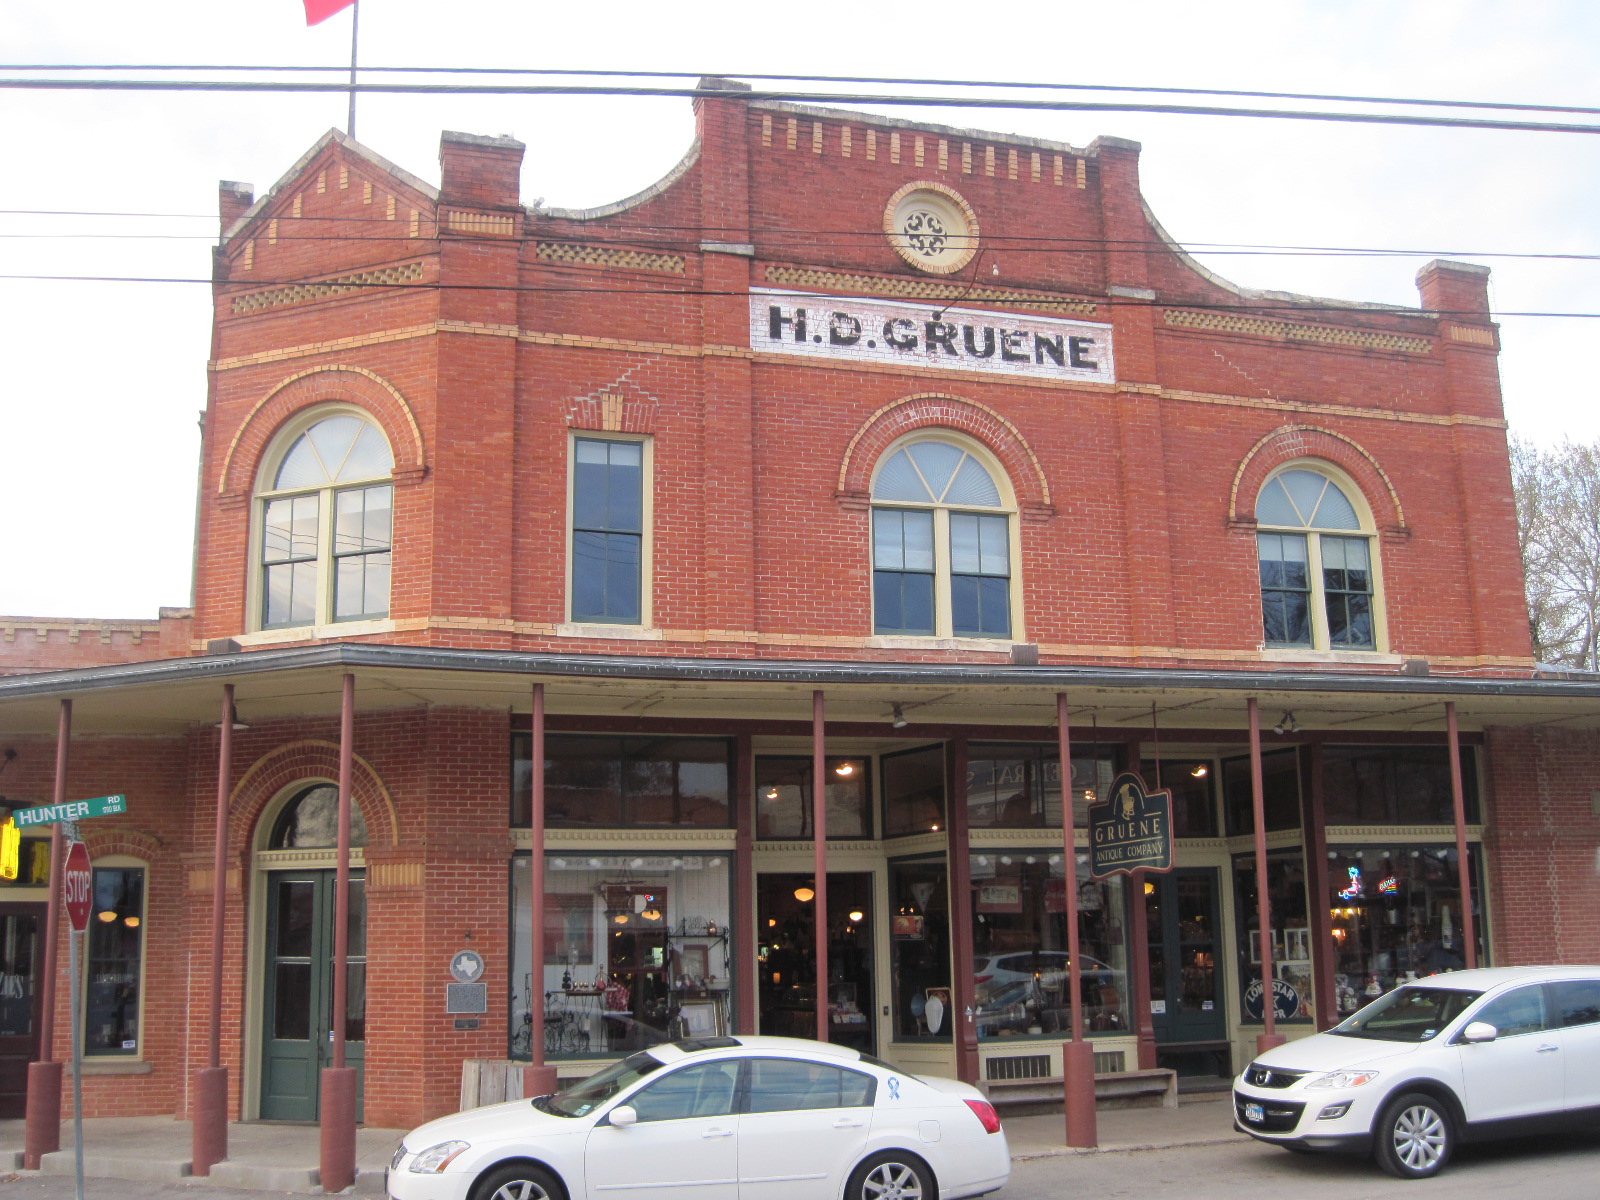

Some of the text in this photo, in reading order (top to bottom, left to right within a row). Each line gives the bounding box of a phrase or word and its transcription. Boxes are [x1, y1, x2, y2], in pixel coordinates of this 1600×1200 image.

[19, 795, 120, 825] HUNTER RD
[1095, 818, 1160, 842] GRUENE
[1096, 841, 1163, 862] ANTIQUE COMPANY
[67, 870, 90, 902] STOP
[1272, 981, 1295, 1001] STAR
